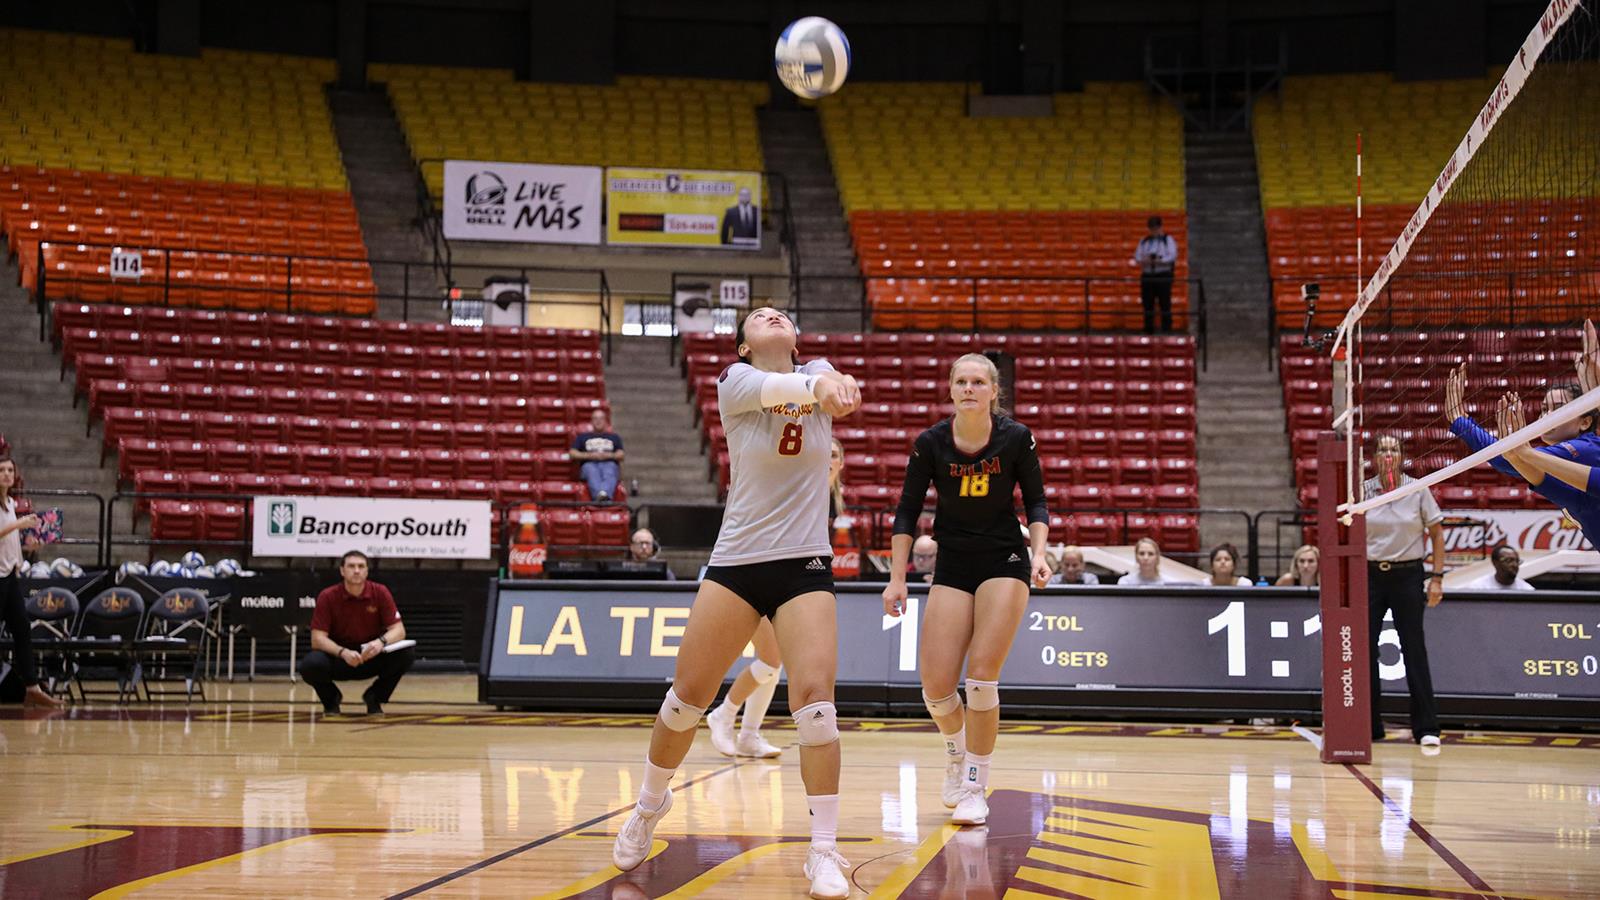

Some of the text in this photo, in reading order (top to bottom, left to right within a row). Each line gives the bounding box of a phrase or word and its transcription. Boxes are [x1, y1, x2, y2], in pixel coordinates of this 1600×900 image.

[514, 181, 567, 202] LIVE
[465, 207, 506, 215] TACO
[466, 217, 506, 225] BELL
[513, 200, 583, 230] MÁS
[113, 256, 139, 272] 114
[724, 286, 746, 300] 115
[778, 421, 804, 456] 8
[949, 456, 1002, 477] ULM
[959, 473, 990, 497] 18
[299, 515, 468, 540] BancorpSouth
[241, 595, 285, 609] molten
[507, 605, 587, 656] LA
[1029, 611, 1084, 631] 2 TOL
[1547, 623, 1593, 640] TOL
[1340, 625, 1353, 662] sports
[1041, 645, 1109, 668] 0 SETS
[1523, 655, 1598, 677] SETS 0
